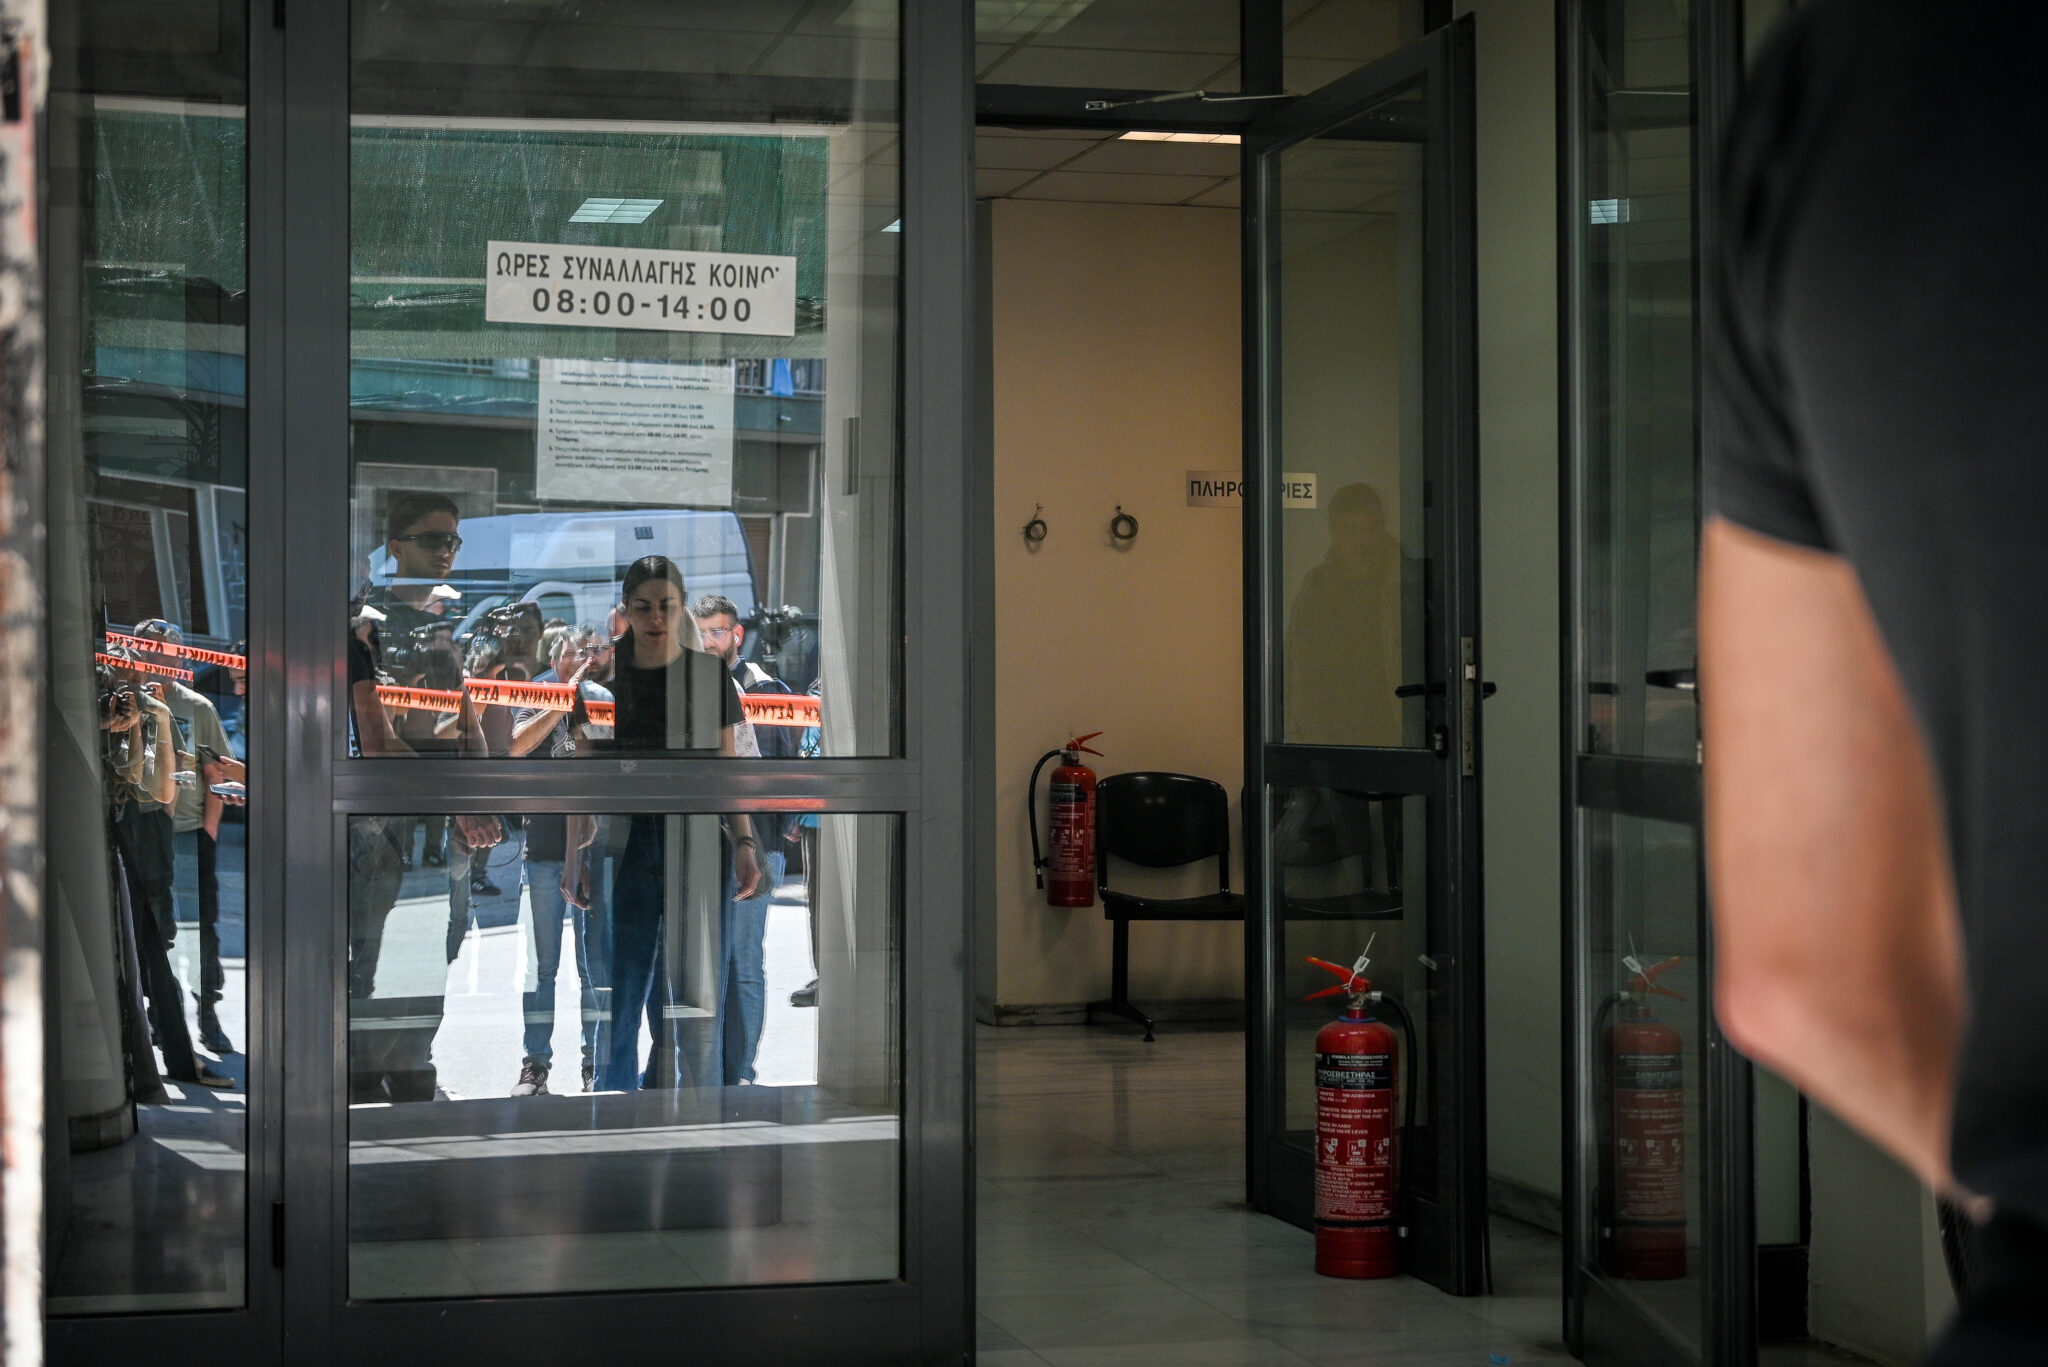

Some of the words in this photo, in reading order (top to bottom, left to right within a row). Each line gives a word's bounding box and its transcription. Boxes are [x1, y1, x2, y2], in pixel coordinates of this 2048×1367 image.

[496, 251, 550, 278] ΩΡΕΣ
[563, 256, 696, 285] ΣΥΝΑΛΛΑΓΗΣ
[709, 263, 779, 288] ΚΟΙΝΟ
[532, 287, 752, 322] 08:00-14:00
[1190, 480, 1313, 499] ΠΛΗΡΙΕΣ
